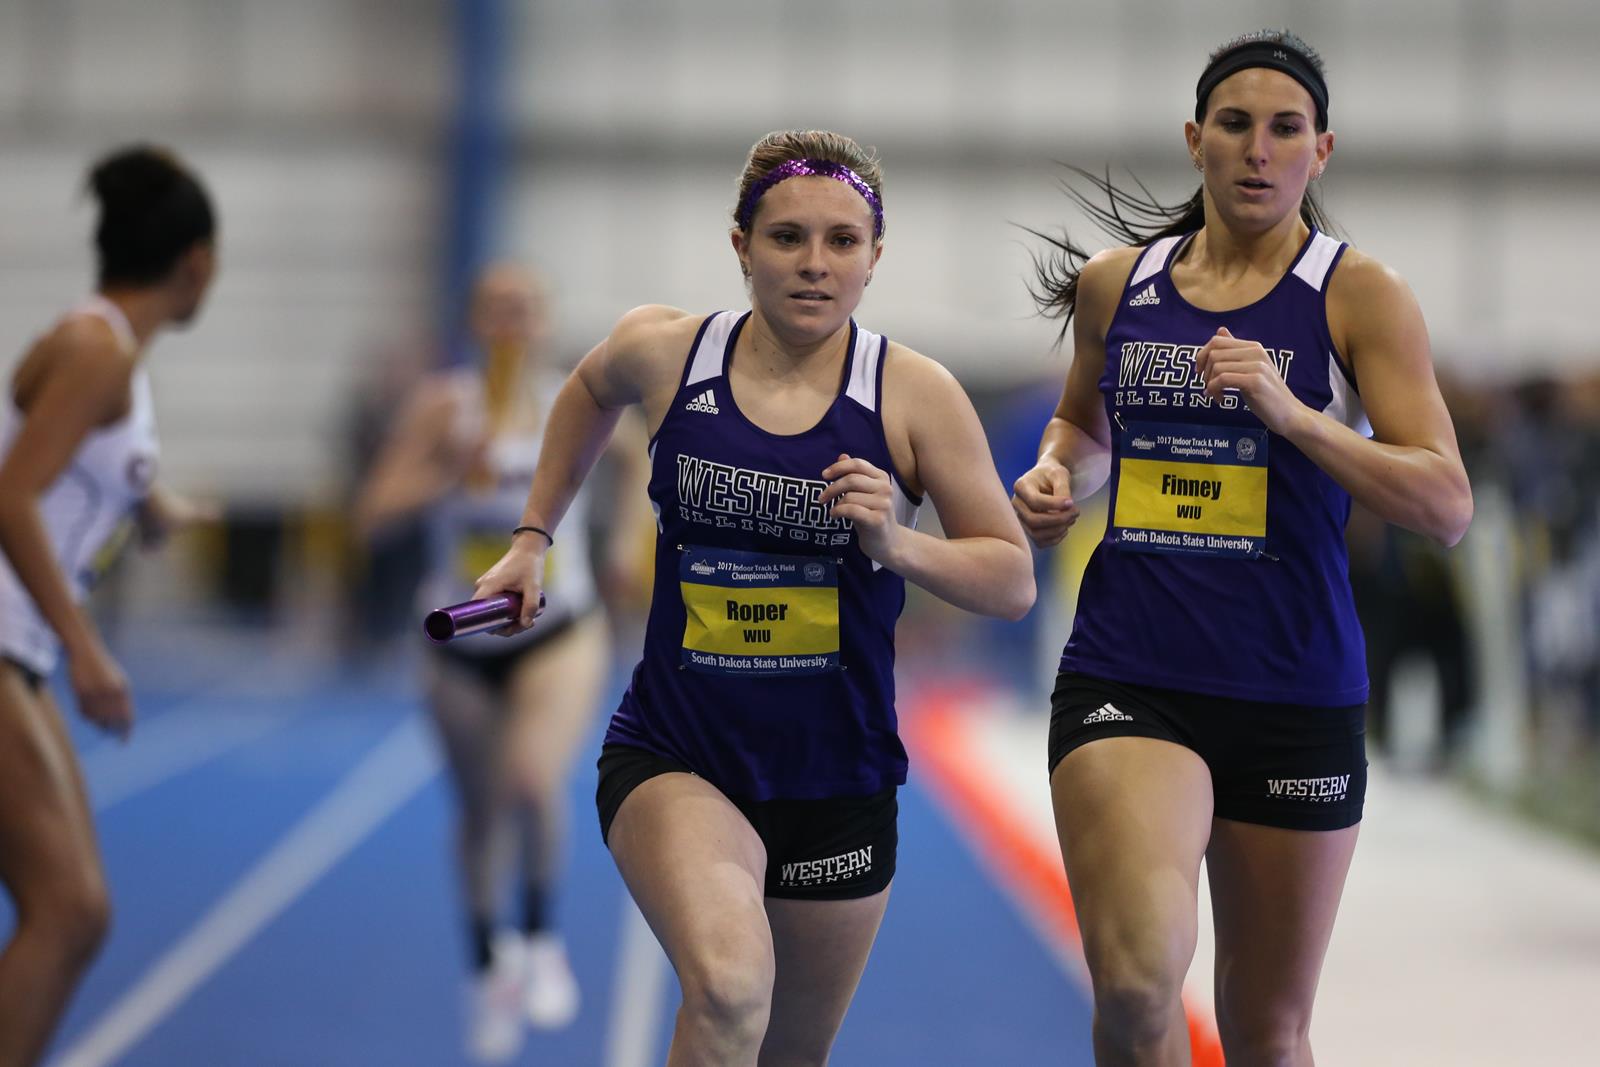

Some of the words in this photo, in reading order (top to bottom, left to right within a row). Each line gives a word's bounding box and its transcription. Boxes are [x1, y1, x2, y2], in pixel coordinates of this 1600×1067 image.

[685, 400, 720, 415] adidas
[1115, 391, 1251, 411] ILLINO
[1157, 435, 1171, 445] 2017
[1172, 436, 1191, 446] Indoor
[1191, 437, 1207, 447] Track
[1207, 438, 1213, 447] &
[1213, 438, 1229, 448] Field
[1170, 446, 1213, 458] Championships
[1161, 474, 1222, 500] Finney
[1177, 504, 1202, 520] WIU
[679, 505, 850, 546] ILLINOIS
[1121, 529, 1148, 543] South
[1149, 532, 1181, 546] Dakota
[1182, 534, 1205, 548] State
[1206, 536, 1254, 553] University
[717, 561, 732, 571] 2017
[732, 563, 753, 572] Indoor
[754, 564, 773, 572] Track
[773, 564, 779, 572] &
[780, 564, 796, 572] Field
[731, 572, 780, 582] Championships
[726, 600, 788, 623] Roper
[743, 629, 771, 643] WIU
[691, 651, 717, 666] South
[718, 655, 752, 669] Dakota
[753, 657, 778, 669] State
[779, 656, 828, 669] University
[1083, 713, 1134, 724] adidas
[1267, 774, 1351, 797] WESTERN
[781, 845, 872, 881] WESTERN
